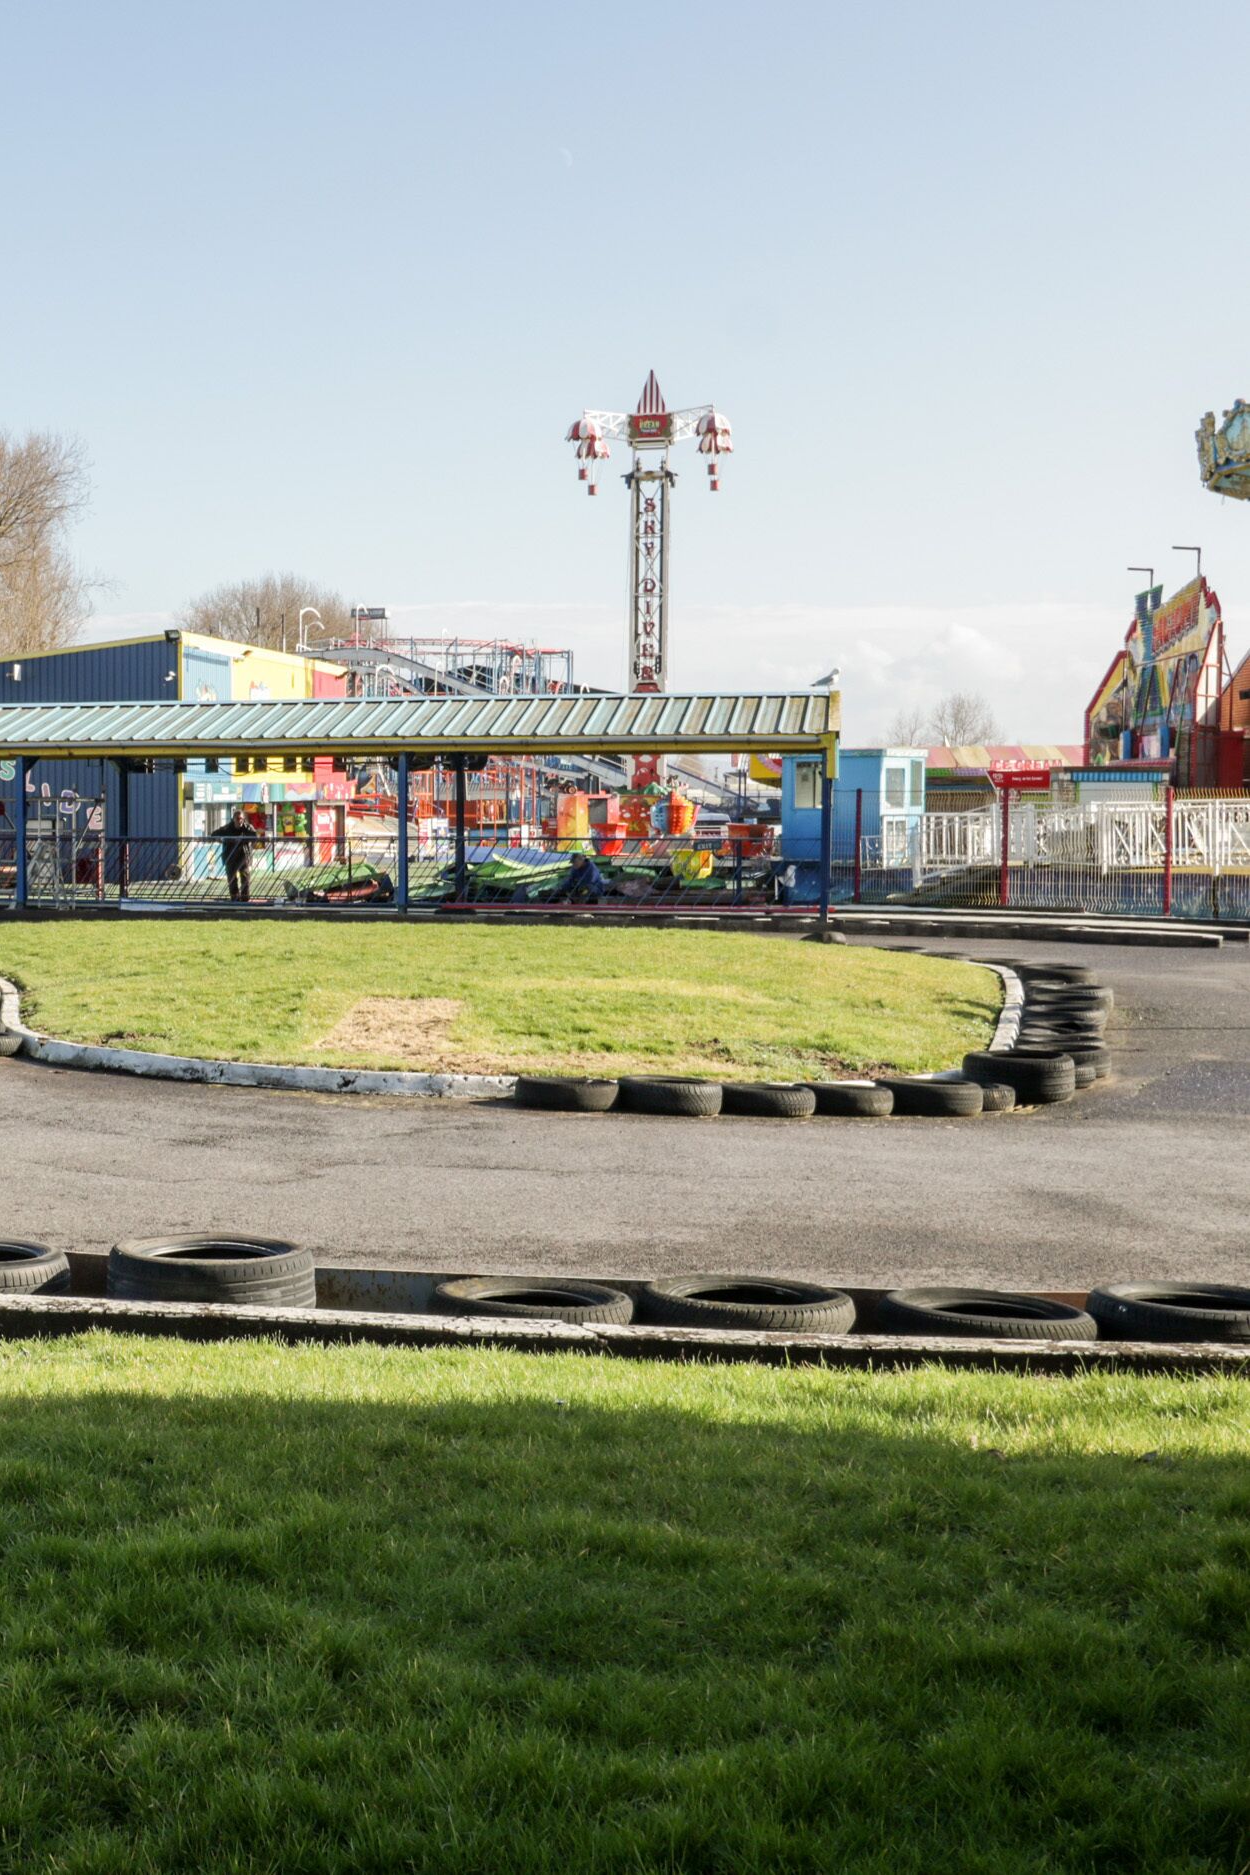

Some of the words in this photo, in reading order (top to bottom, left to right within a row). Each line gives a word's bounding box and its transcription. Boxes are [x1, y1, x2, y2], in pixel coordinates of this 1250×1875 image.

[643, 497, 657, 557] SKY
[641, 577, 657, 682] DIVER
[1014, 760, 1062, 771] CREAM
